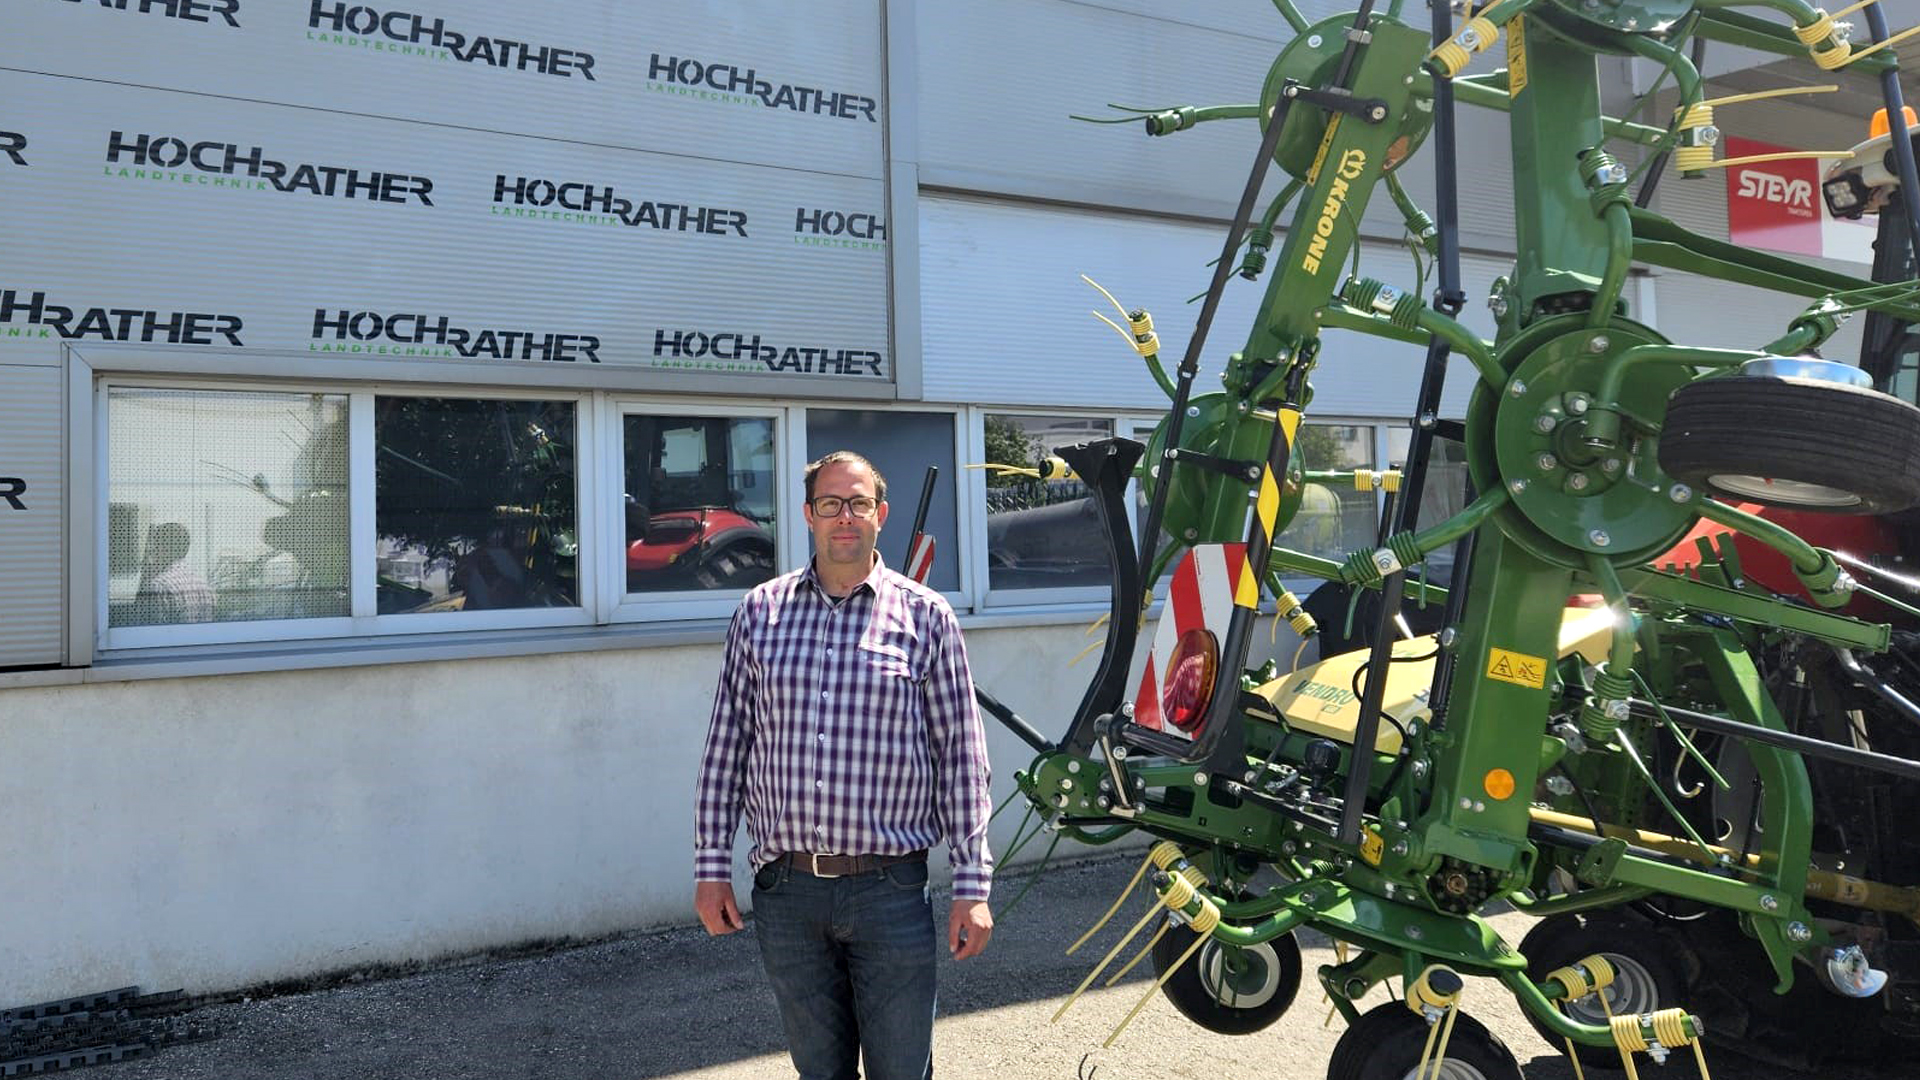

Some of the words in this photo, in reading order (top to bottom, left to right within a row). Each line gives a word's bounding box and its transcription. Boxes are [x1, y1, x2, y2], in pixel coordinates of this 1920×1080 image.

[306, 31, 449, 61] LANDTECHNIK
[308, 0, 597, 82] HOCHRATHER
[645, 81, 760, 108] LANDTECHNIK
[648, 53, 878, 123] HOCHRATHER
[104, 166, 268, 191] LANDTECHNIK
[106, 130, 435, 207] HOCHRATHER
[1738, 169, 1812, 208] STEYR
[491, 205, 619, 228] LANDTECHNIK
[493, 174, 749, 238] HOCHRATHER
[795, 207, 887, 241] HOCH
[1302, 176, 1349, 277] KRONE
[0, 289, 244, 347] HRATHER
[0, 327, 50, 338] NIK
[312, 308, 601, 363] HOCHRATHER
[310, 343, 453, 357] LANDTECHNIK
[653, 328, 882, 377] HOCHRATHER
